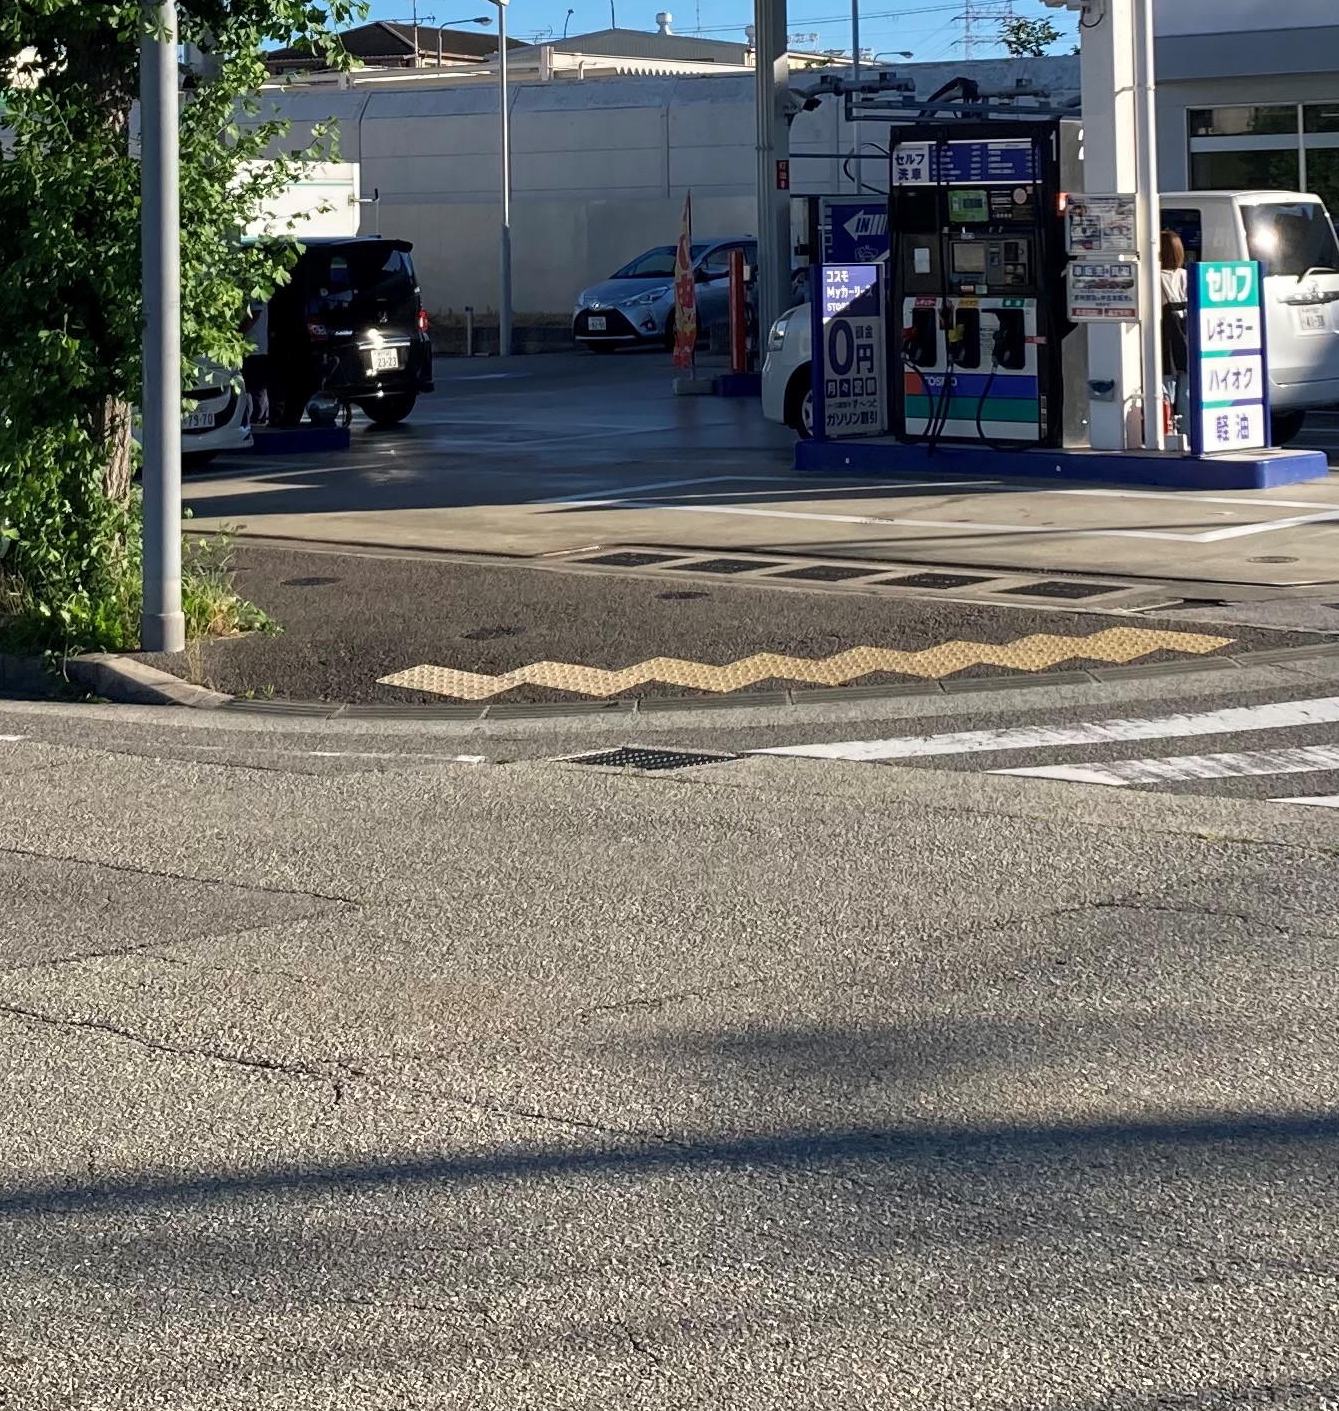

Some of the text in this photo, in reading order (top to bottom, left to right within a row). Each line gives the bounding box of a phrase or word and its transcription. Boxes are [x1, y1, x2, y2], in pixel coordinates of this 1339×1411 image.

[895, 153, 925, 165] セルフ
[855, 217, 870, 232] IN
[826, 270, 849, 282] コスモ
[1206, 267, 1252, 302] セルフ
[1207, 316, 1253, 341] レギュラー
[1209, 367, 1253, 391] ハイオク
